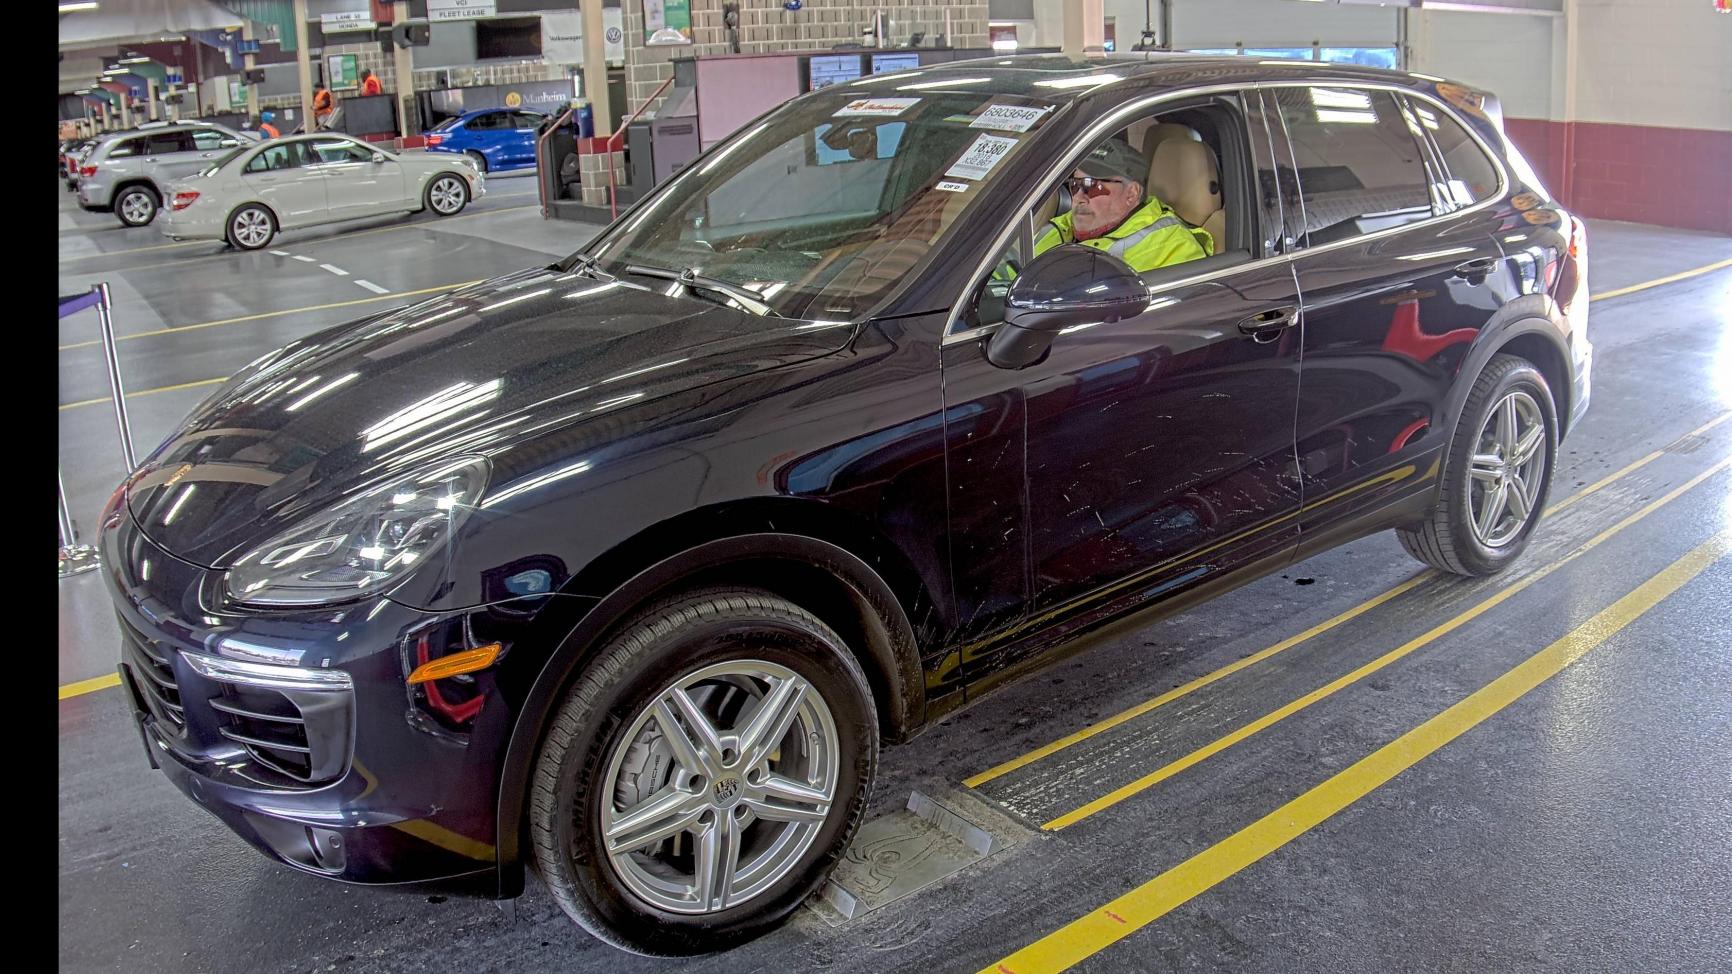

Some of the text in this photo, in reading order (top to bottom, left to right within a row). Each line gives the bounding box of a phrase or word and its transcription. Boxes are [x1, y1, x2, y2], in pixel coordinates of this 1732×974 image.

[438, 9, 486, 18] FLEET LEASE
[522, 91, 567, 104] Manheim
[984, 107, 1038, 120] 6803646
[648, 754, 661, 798] RSCHE
